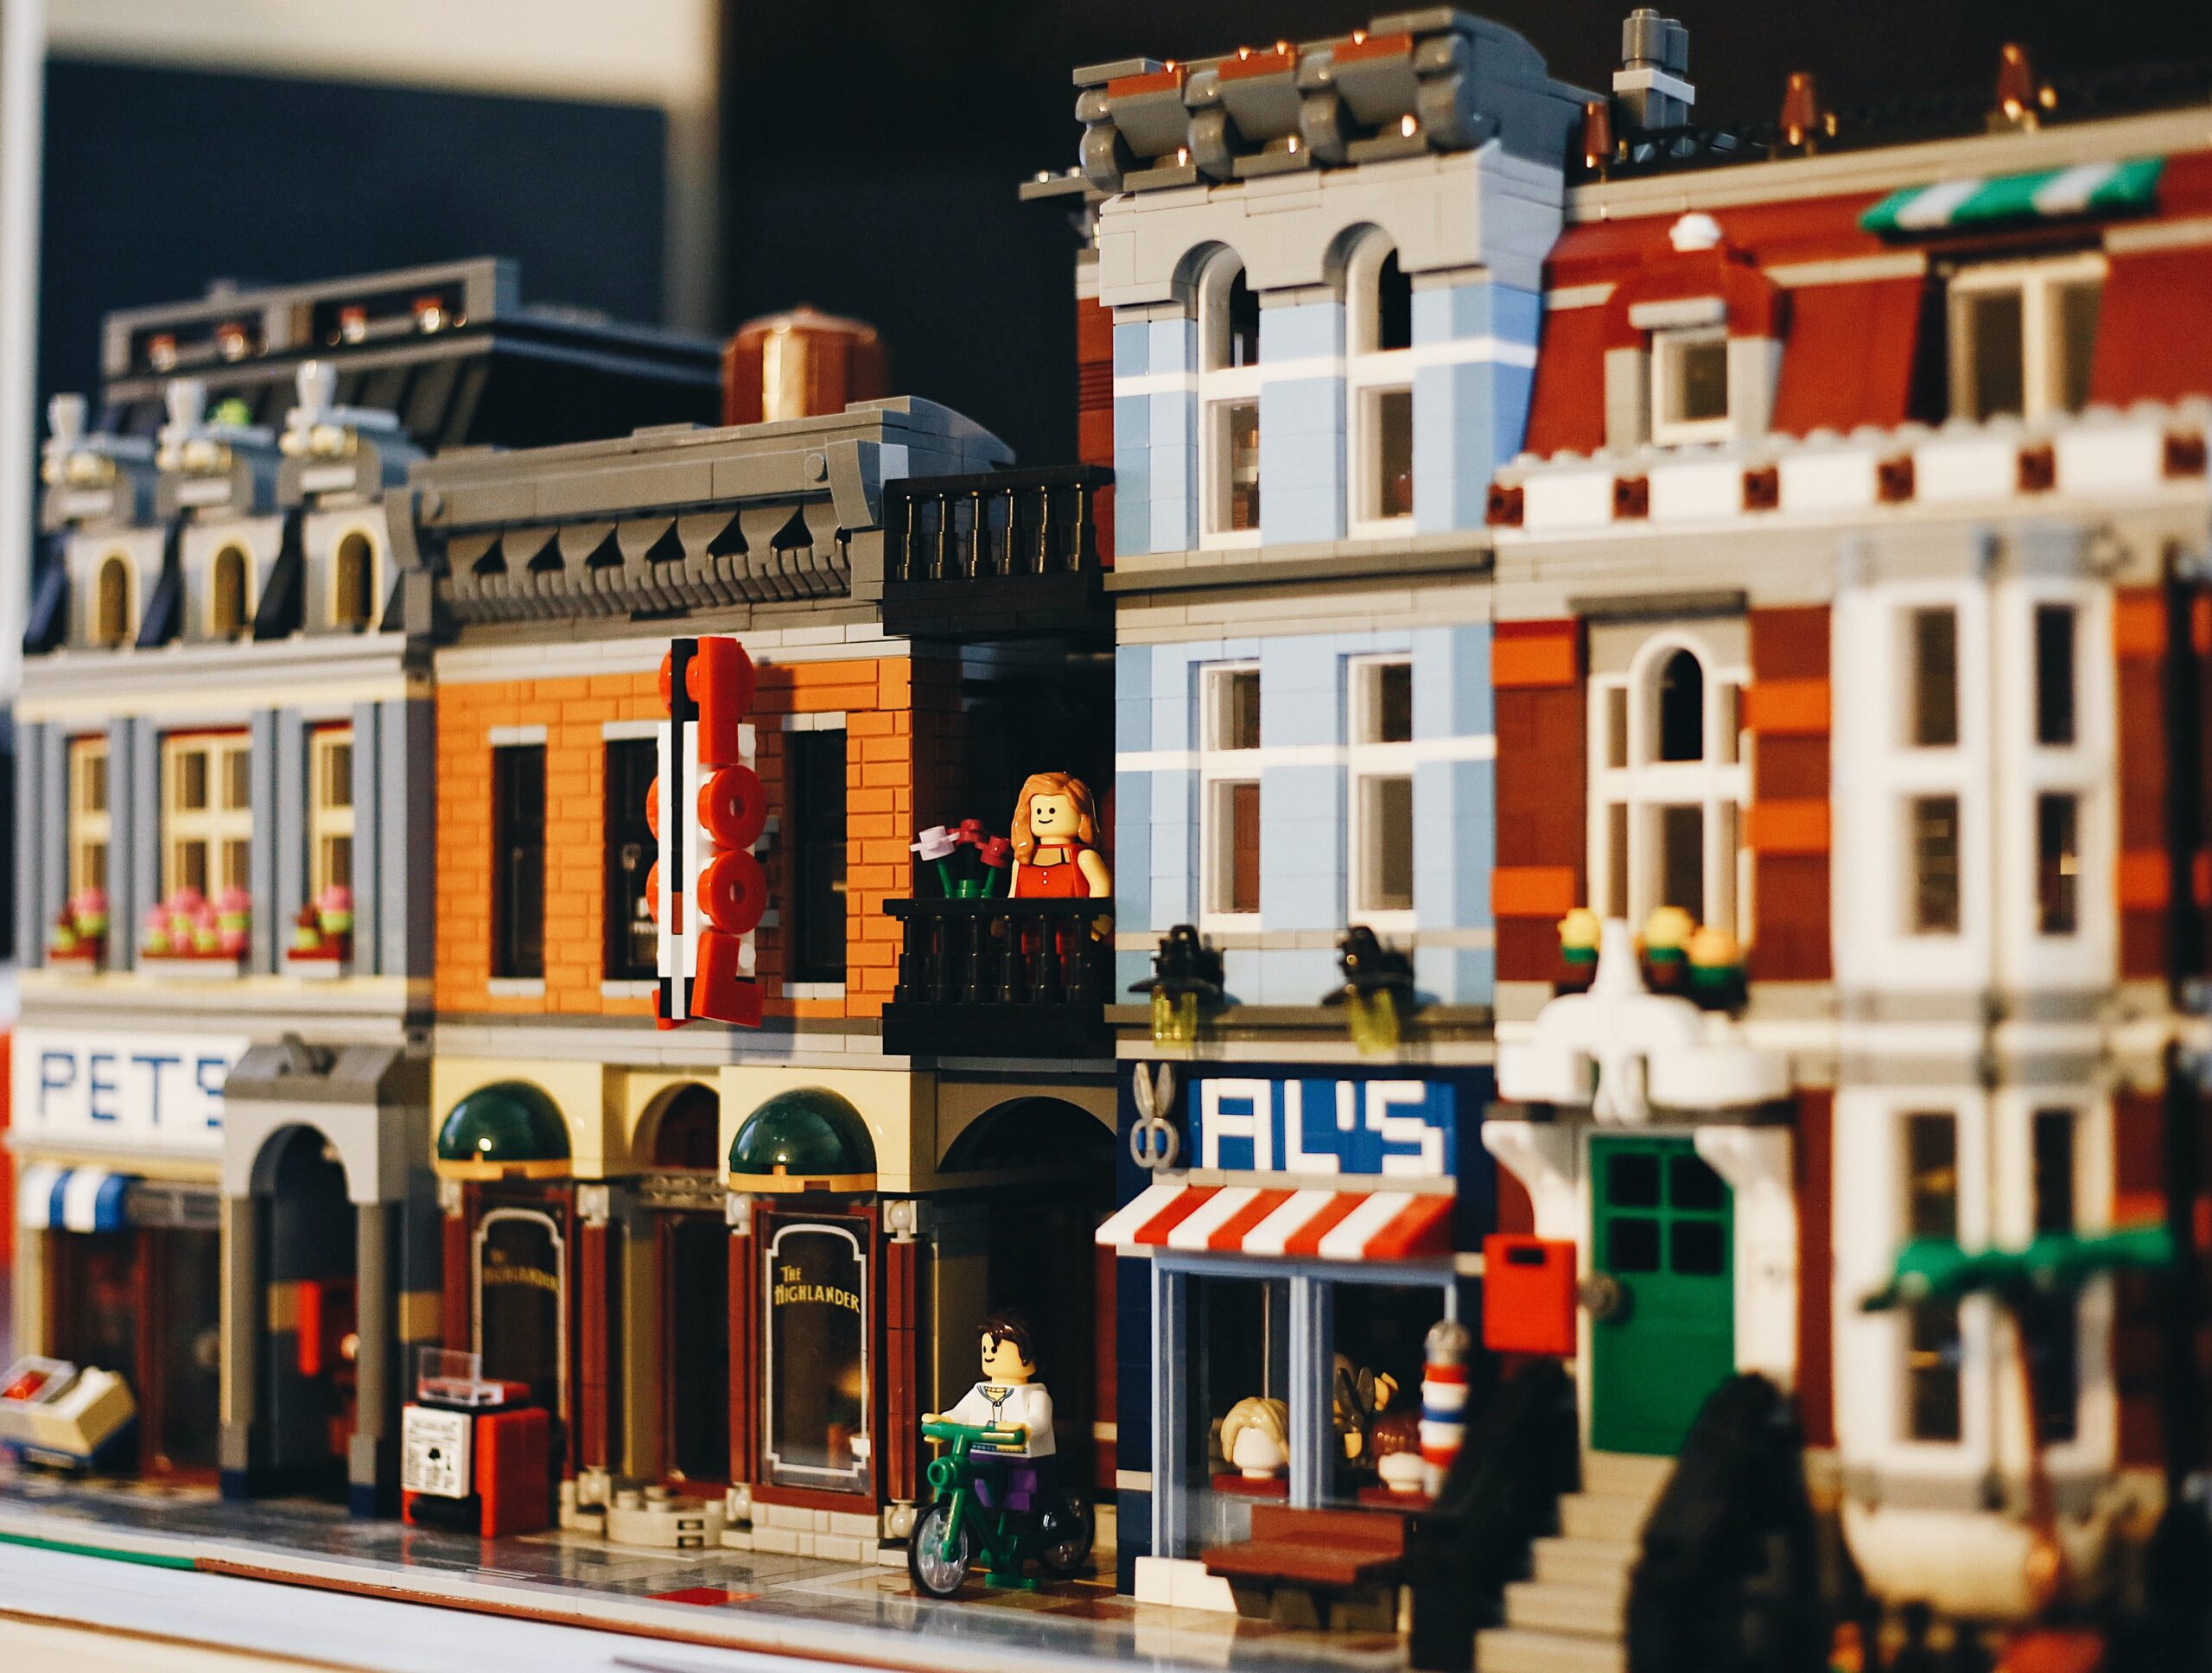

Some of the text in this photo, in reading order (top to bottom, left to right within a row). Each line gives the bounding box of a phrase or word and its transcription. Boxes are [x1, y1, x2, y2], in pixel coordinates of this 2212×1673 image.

[41, 1051, 224, 1127] PETS
[1201, 1078, 1444, 1176] AL'S
[774, 1284, 861, 1314] HIGHLANDER
